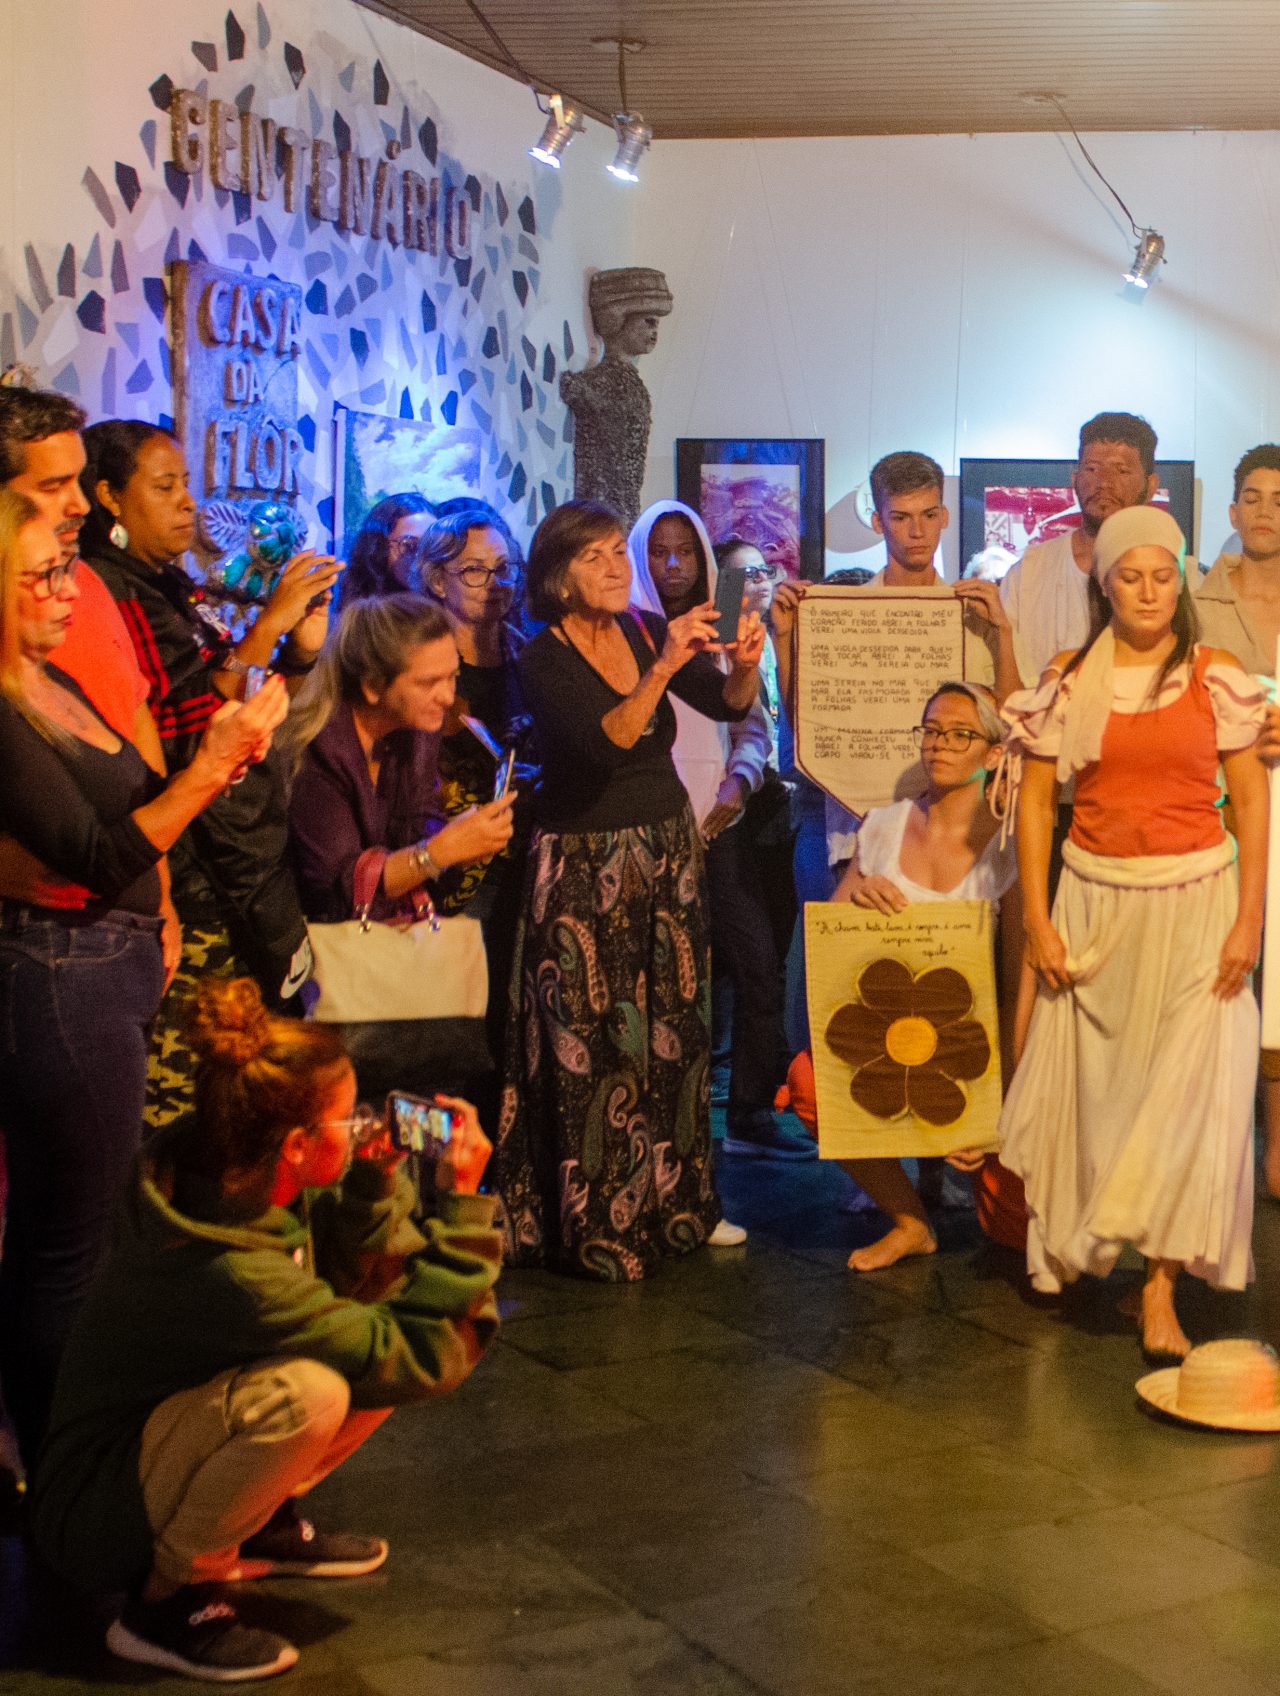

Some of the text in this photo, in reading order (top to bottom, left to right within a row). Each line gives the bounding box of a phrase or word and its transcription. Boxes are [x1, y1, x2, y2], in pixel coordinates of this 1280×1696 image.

[171, 88, 472, 260] CENTENÁRIO
[197, 280, 302, 358] CASA
[224, 361, 265, 408] DA
